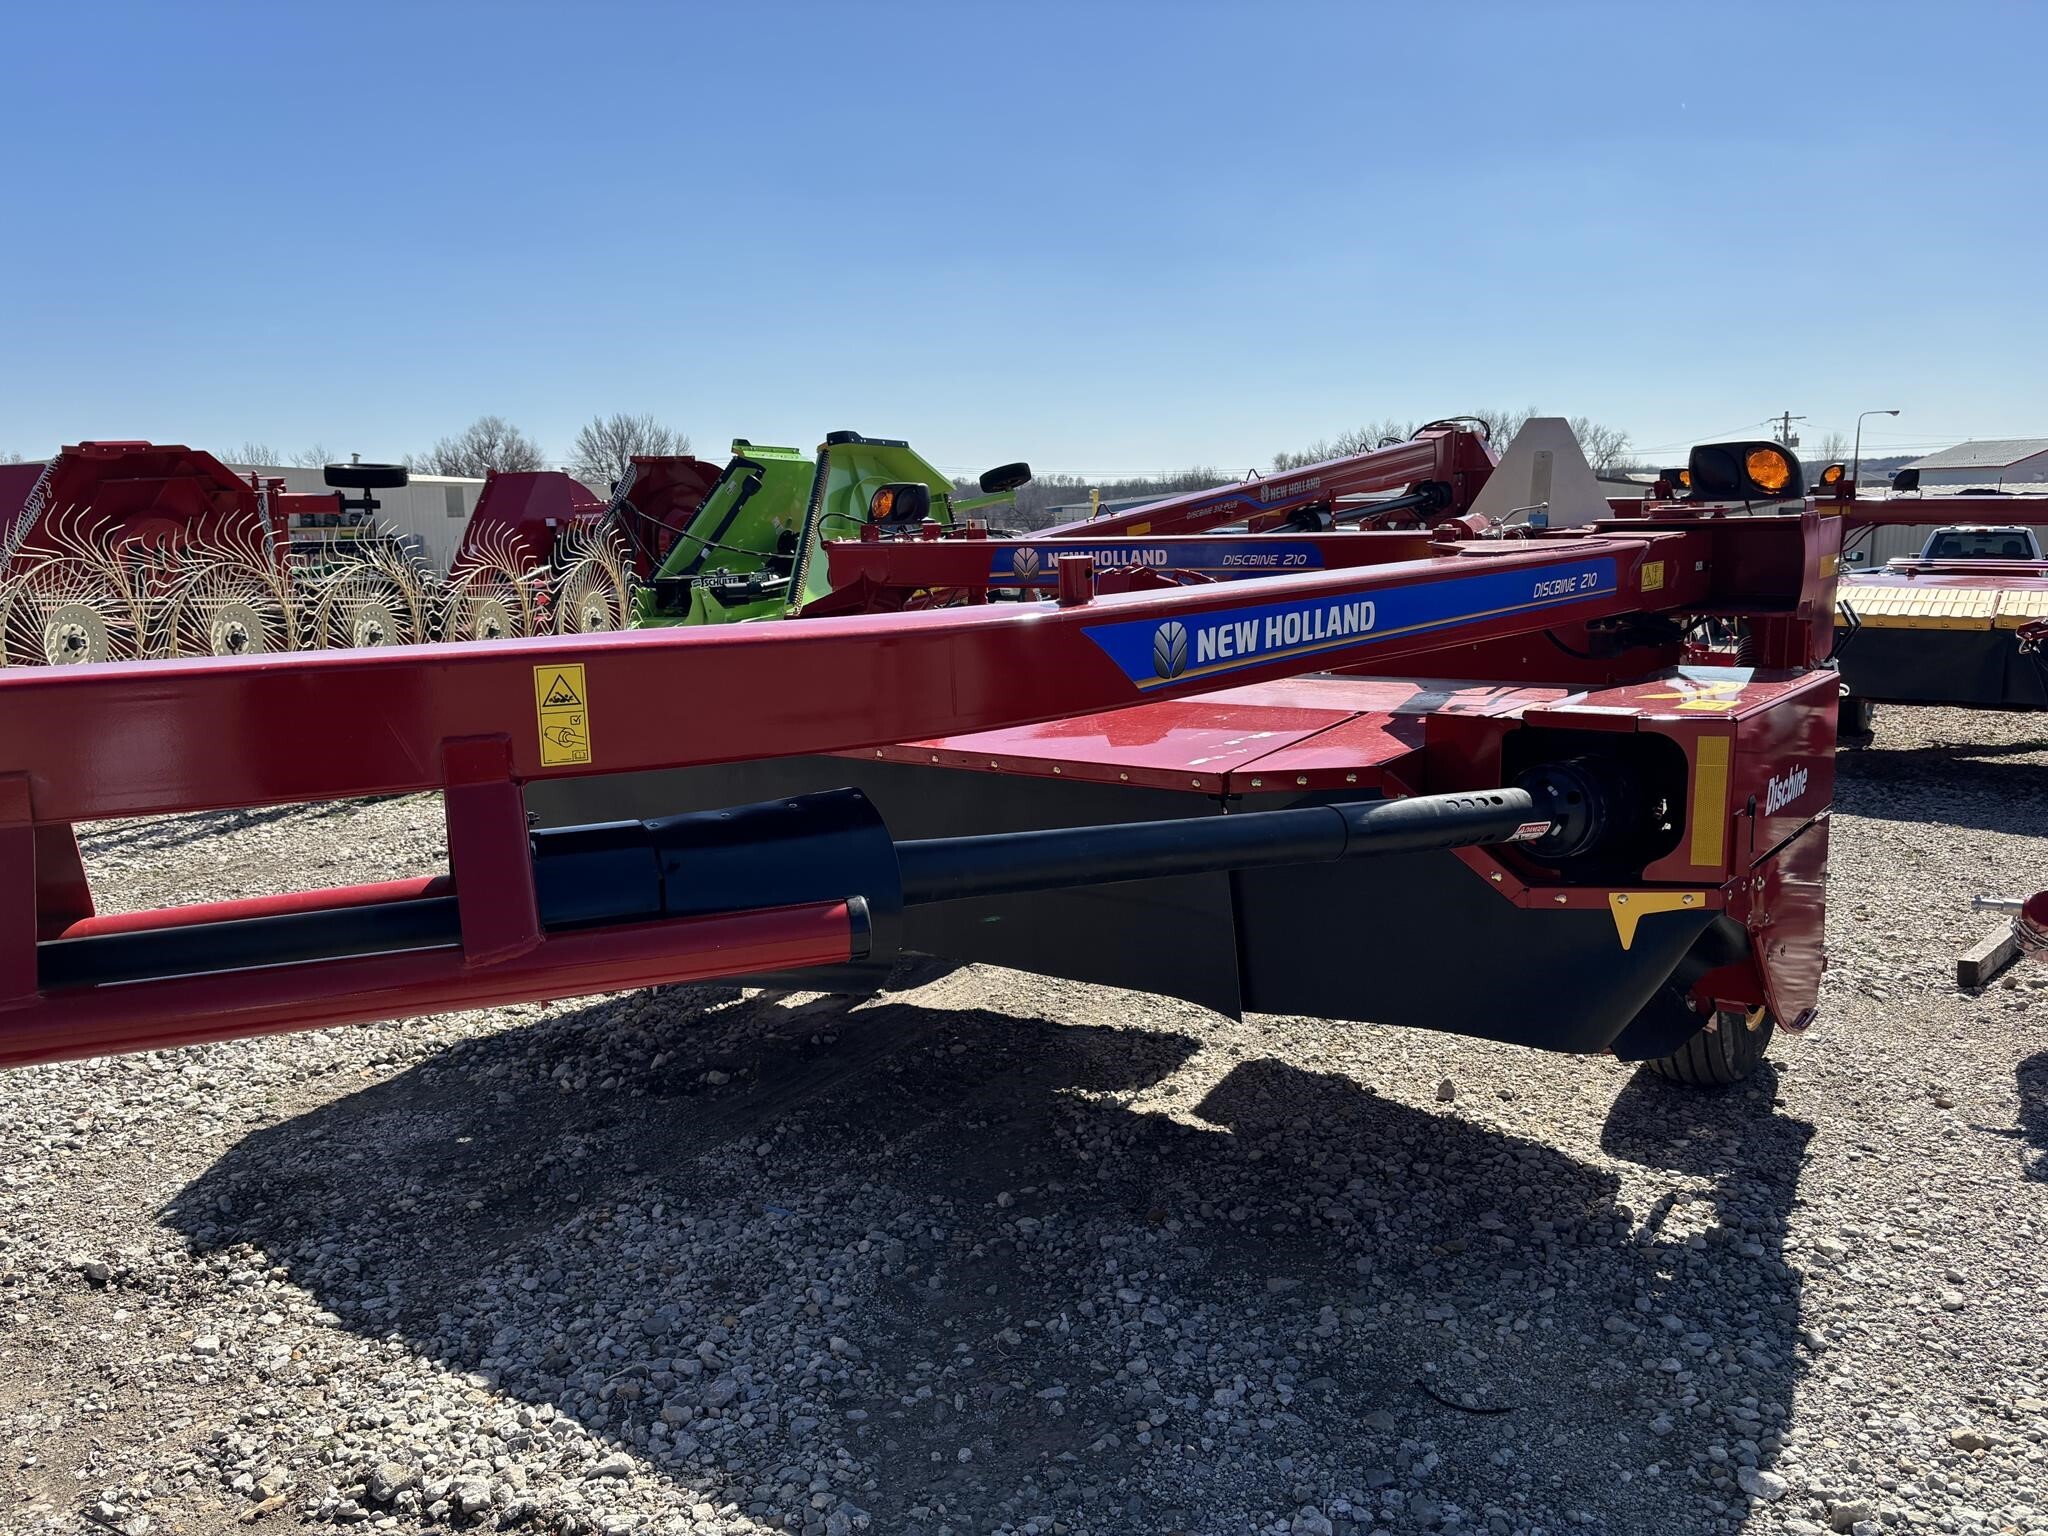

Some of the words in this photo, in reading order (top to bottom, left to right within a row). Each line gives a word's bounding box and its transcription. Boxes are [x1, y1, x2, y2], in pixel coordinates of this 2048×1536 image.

[1270, 484, 1287, 501] NEW
[1288, 477, 1320, 496] HOLLAND
[1089, 549, 1167, 566] HOLLAND
[1222, 554, 1279, 566] DISCBINE
[1282, 554, 1307, 565] 210
[703, 576, 739, 587] SCHULTE
[1533, 576, 1577, 599] DISCBINE
[1580, 572, 1598, 589] 210
[1197, 619, 1259, 663] NEW
[1265, 601, 1376, 649] HOLLAND
[1765, 763, 1808, 817] Discbine
